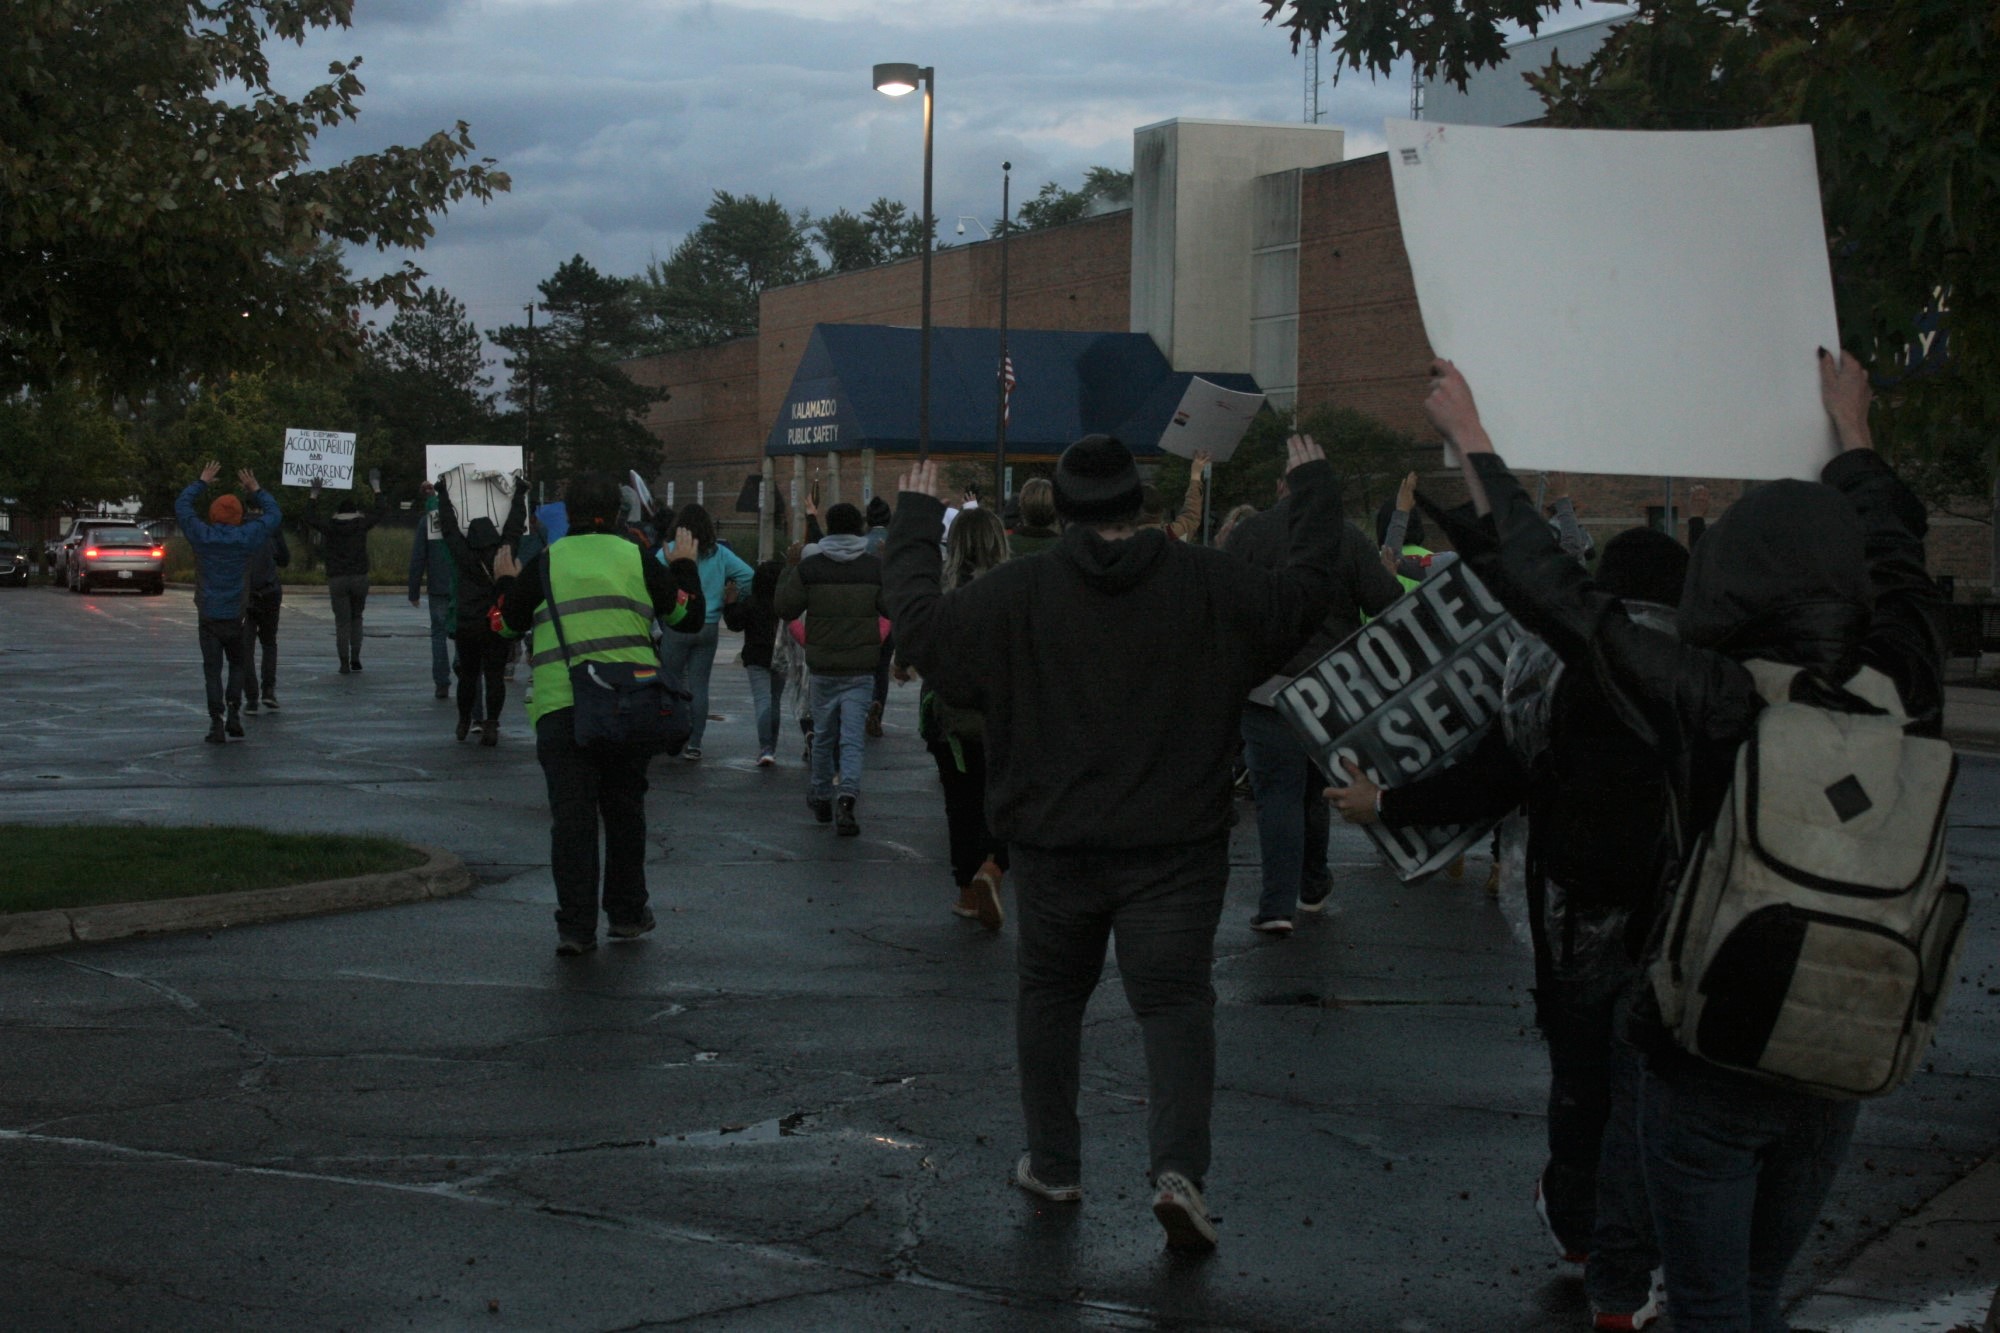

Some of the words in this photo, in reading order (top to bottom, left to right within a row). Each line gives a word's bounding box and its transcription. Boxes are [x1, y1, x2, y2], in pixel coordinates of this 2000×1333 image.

[791, 398, 837, 420] KALAMAZOO
[787, 426, 812, 445] PUBLIC
[813, 424, 839, 443] SAFETY
[285, 436, 356, 456] ACCOUNTABILITY
[284, 462, 353, 481] TRANSPARENCY
[1377, 618, 1524, 774] SERV
